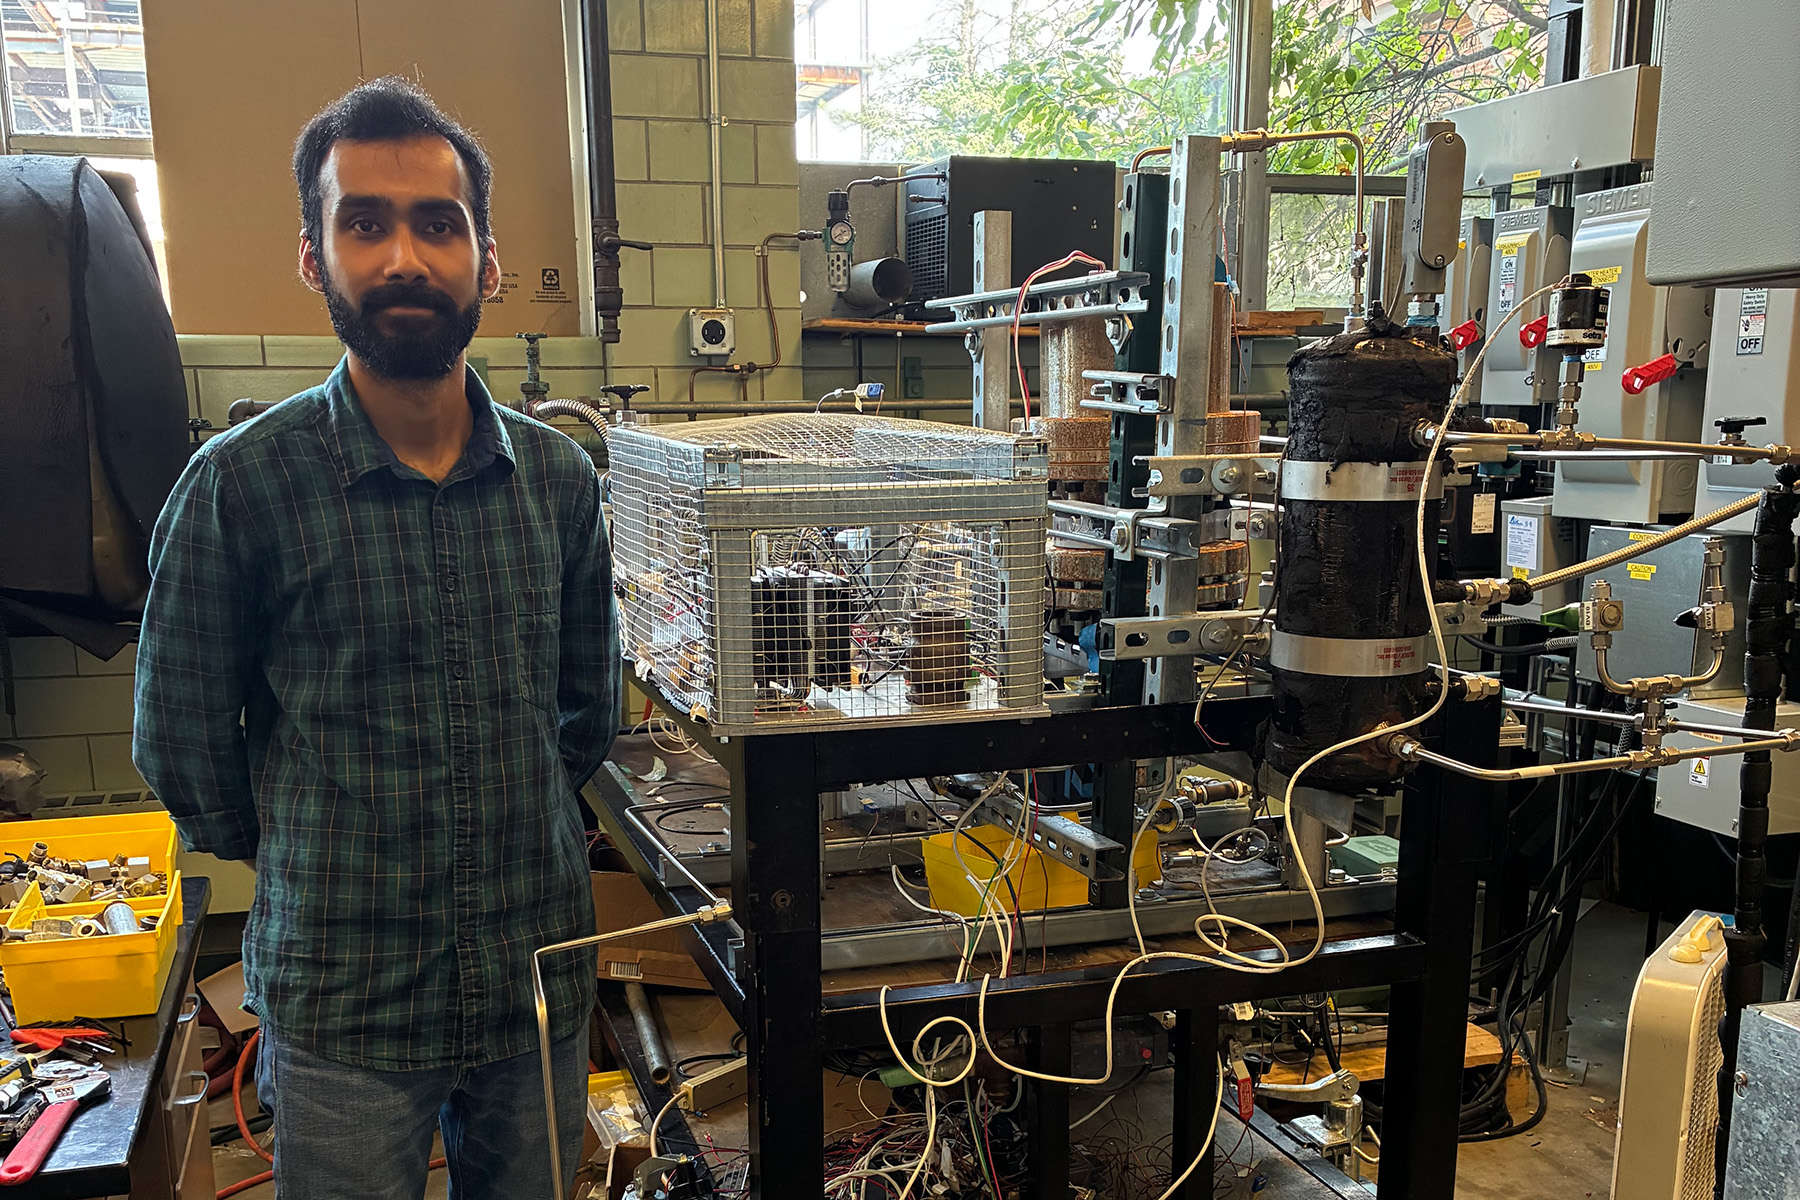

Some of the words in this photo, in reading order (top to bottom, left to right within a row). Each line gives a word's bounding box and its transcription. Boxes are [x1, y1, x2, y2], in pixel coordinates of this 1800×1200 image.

[1585, 184, 1653, 216] SIEMEN
[1500, 211, 1539, 228] SIEMENS
[1505, 261, 1514, 269] ON
[1500, 300, 1511, 309] OFF
[1741, 338, 1761, 350] OFF
[1584, 349, 1601, 360] OFF
[1630, 564, 1652, 573] CAUTION
